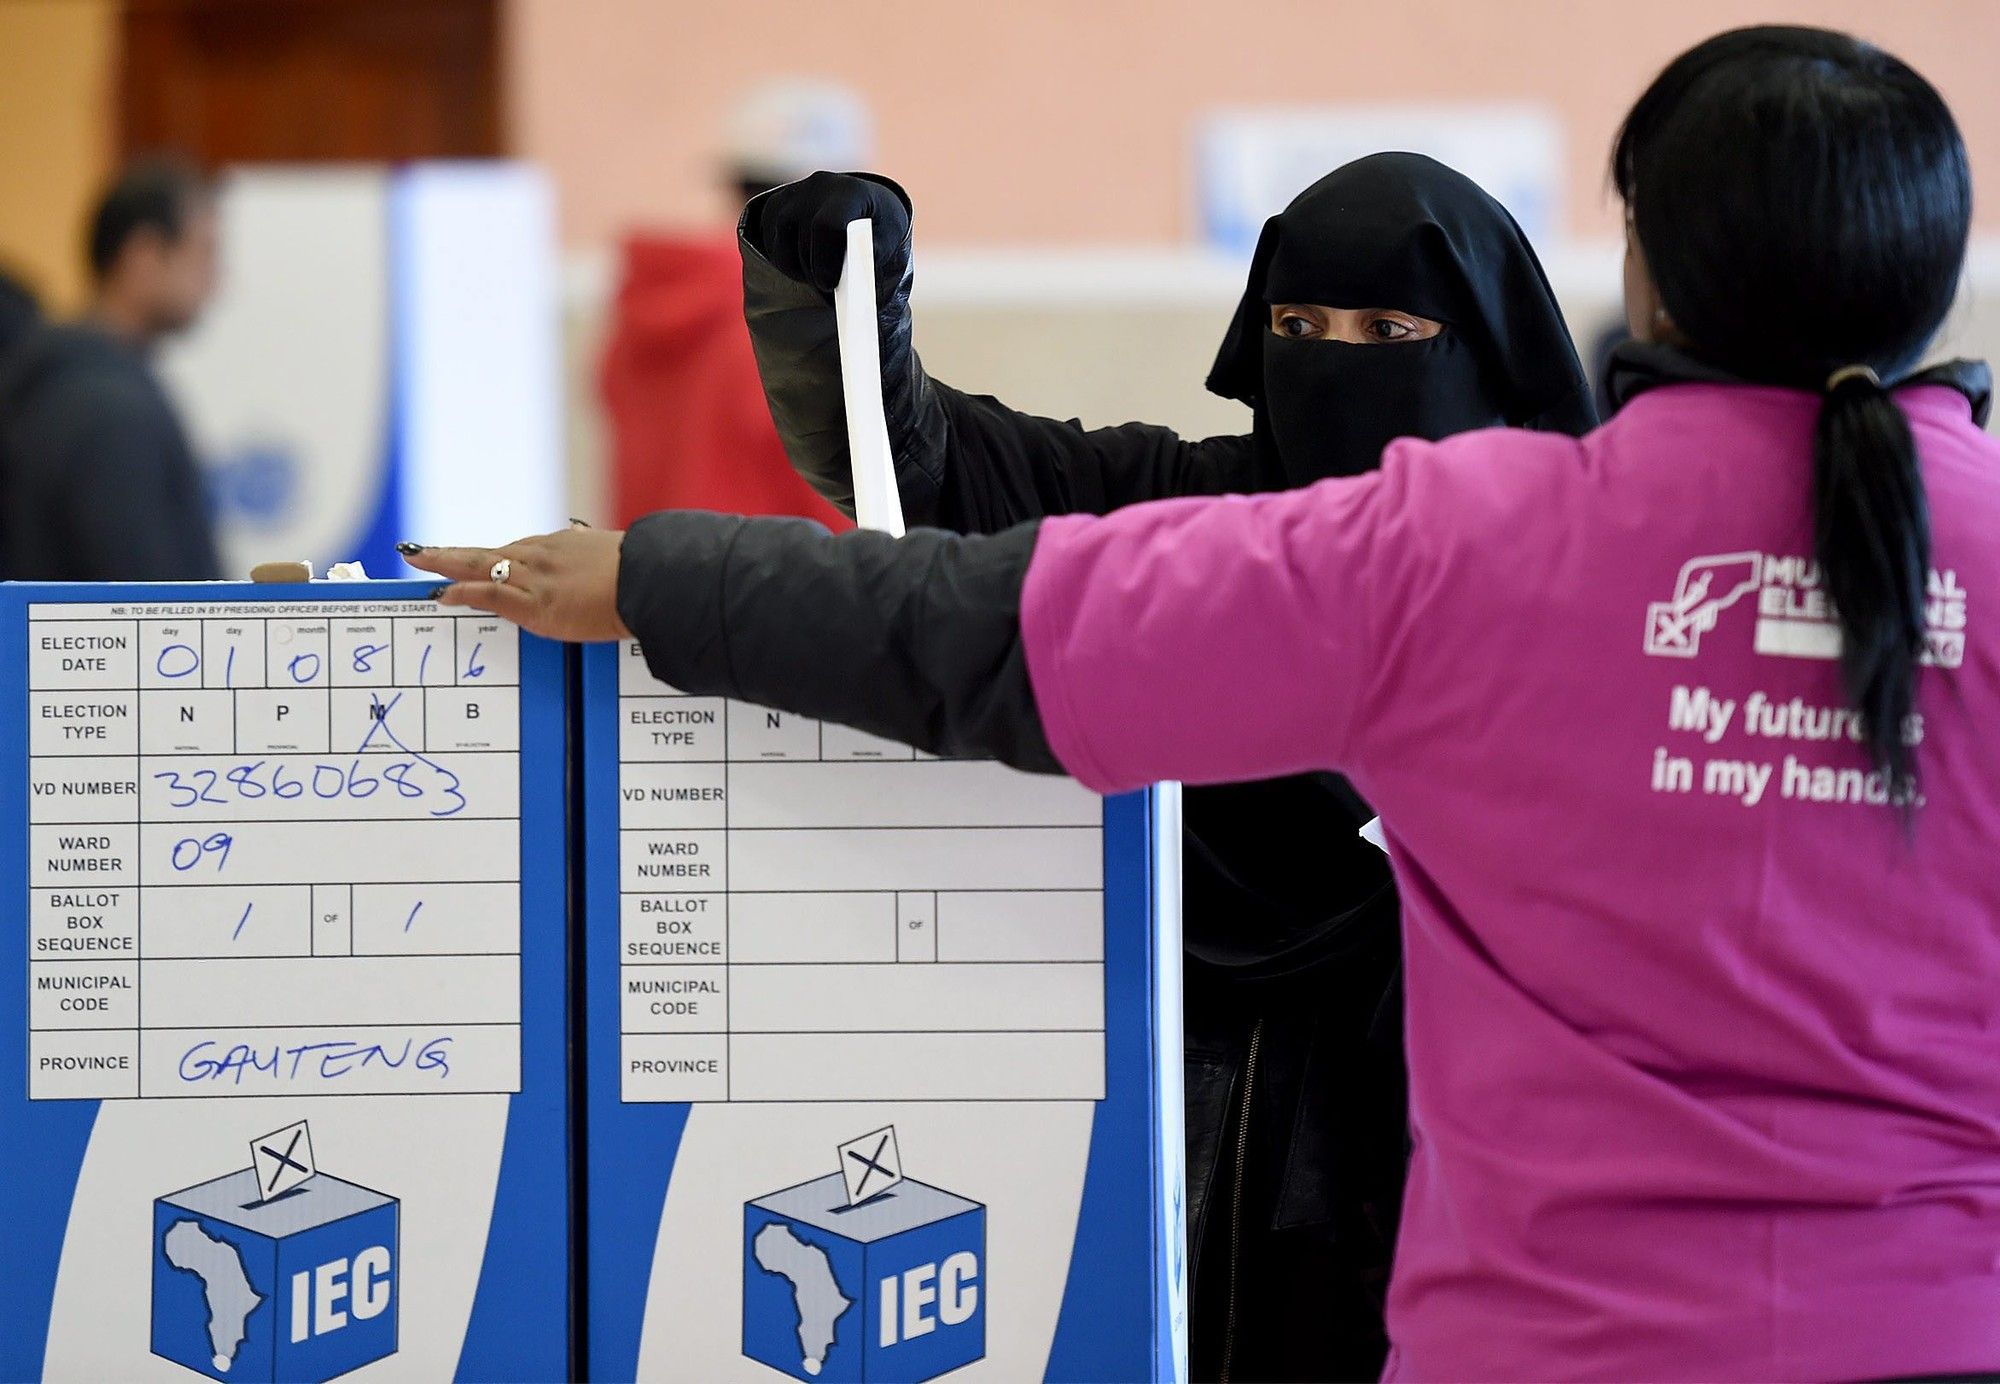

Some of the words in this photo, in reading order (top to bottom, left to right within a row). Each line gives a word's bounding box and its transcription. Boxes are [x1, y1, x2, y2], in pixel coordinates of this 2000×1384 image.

[131, 606, 143, 615] TO
[146, 606, 159, 615] BE
[161, 606, 194, 615] FILLED
[196, 606, 206, 614] IN
[209, 606, 221, 614] BY
[224, 605, 276, 614] PRESIDING
[278, 605, 319, 614] OFFICER
[321, 604, 361, 613] BEFORE
[364, 604, 399, 613] VOTING
[401, 604, 438, 613] STARTS
[162, 627, 179, 637] day
[225, 627, 242, 637] day
[297, 626, 326, 634] month
[347, 625, 376, 634] month
[414, 625, 435, 635] year
[478, 625, 499, 635] year
[42, 636, 127, 651] ELECTION
[61, 657, 106, 672] DATE
[157, 645, 199, 678] 0
[287, 653, 321, 683] 0
[353, 644, 389, 673] 8
[462, 643, 486, 678] 6
[42, 704, 127, 719] ELECTION
[180, 706, 194, 722] N
[275, 705, 289, 721] P
[466, 703, 480, 719] B
[631, 710, 715, 725] ELECTION
[1669, 685, 1736, 743] My
[767, 712, 781, 728] N
[62, 725, 106, 740] TYPE
[651, 731, 695, 745] TYPE
[1651, 746, 1694, 793] in
[1702, 758, 1773, 807] my
[33, 782, 57, 796] VD
[62, 781, 136, 796] NUMBER
[154, 761, 466, 816] 32860683
[623, 787, 645, 801] VD
[651, 787, 724, 801] NUMBER
[59, 836, 110, 851] WARD
[648, 842, 699, 856] WARD
[172, 833, 233, 872] 09
[48, 858, 122, 872] NUMBER
[637, 864, 710, 878] NUMBER
[51, 893, 120, 908] BALLOT
[641, 899, 708, 912] BALLOT
[67, 915, 103, 930] BOX
[323, 914, 338, 923] OF
[909, 920, 923, 930] OF
[656, 921, 692, 935] BOX
[37, 937, 132, 952] SEQUENCE
[628, 942, 721, 957] SEQUENCE
[38, 976, 131, 990] MUNICIPAL
[628, 980, 720, 994] MUNICIPAL
[60, 998, 109, 1012] CODE
[650, 1001, 698, 1016] CODE
[40, 1056, 129, 1071] PROVINCE
[179, 1037, 453, 1085] GAUTENG
[631, 1059, 718, 1074] PROVINCE
[291, 1245, 391, 1344] IEC
[880, 1250, 978, 1349] IEC
